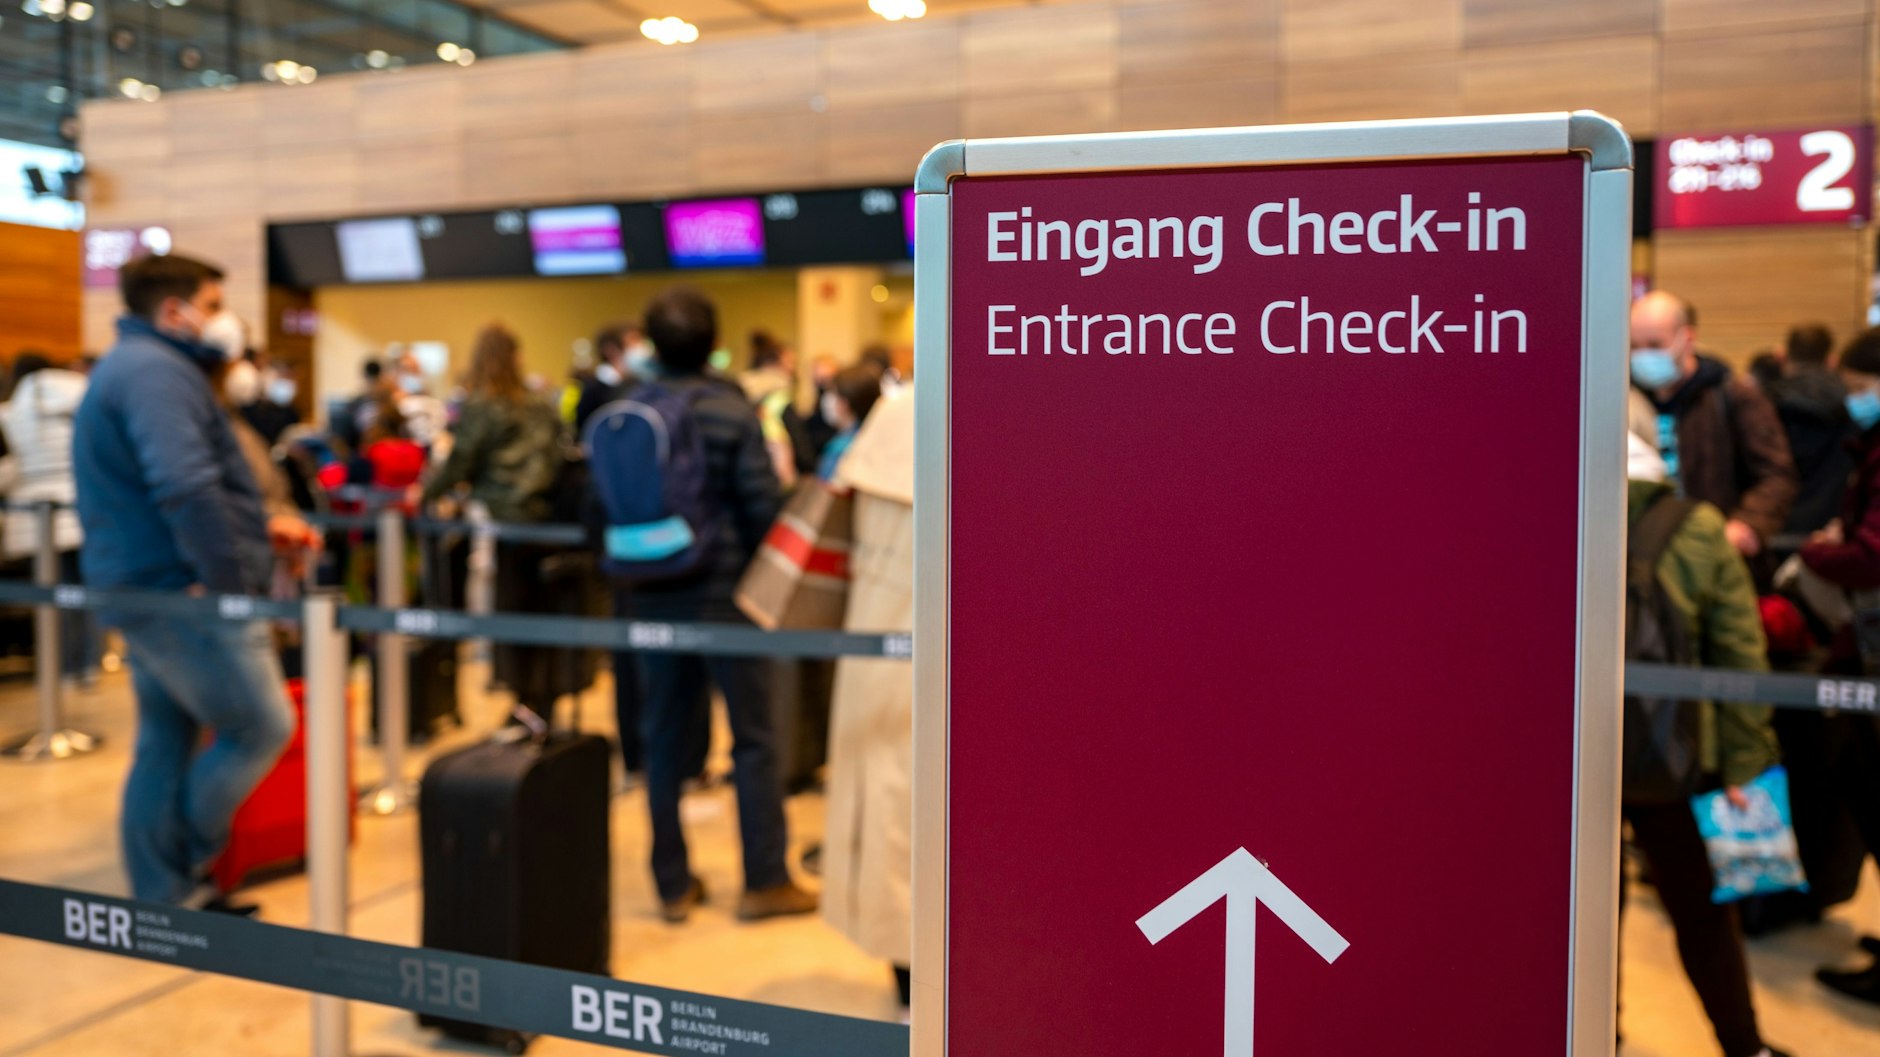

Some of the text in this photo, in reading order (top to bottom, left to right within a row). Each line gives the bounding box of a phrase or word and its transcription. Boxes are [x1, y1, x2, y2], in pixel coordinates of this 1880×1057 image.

[1796, 130, 1856, 211] 2
[987, 191, 1528, 277] Eingang Check-in
[987, 293, 1529, 356] Entrance Check-in
[1816, 679, 1877, 711] BER
[63, 898, 133, 950] BER
[571, 984, 664, 1045] BER
[671, 1001, 717, 1020] BERLIN
[671, 1017, 770, 1046] BRANDENBURG
[671, 1034, 727, 1057] AIRPORT
